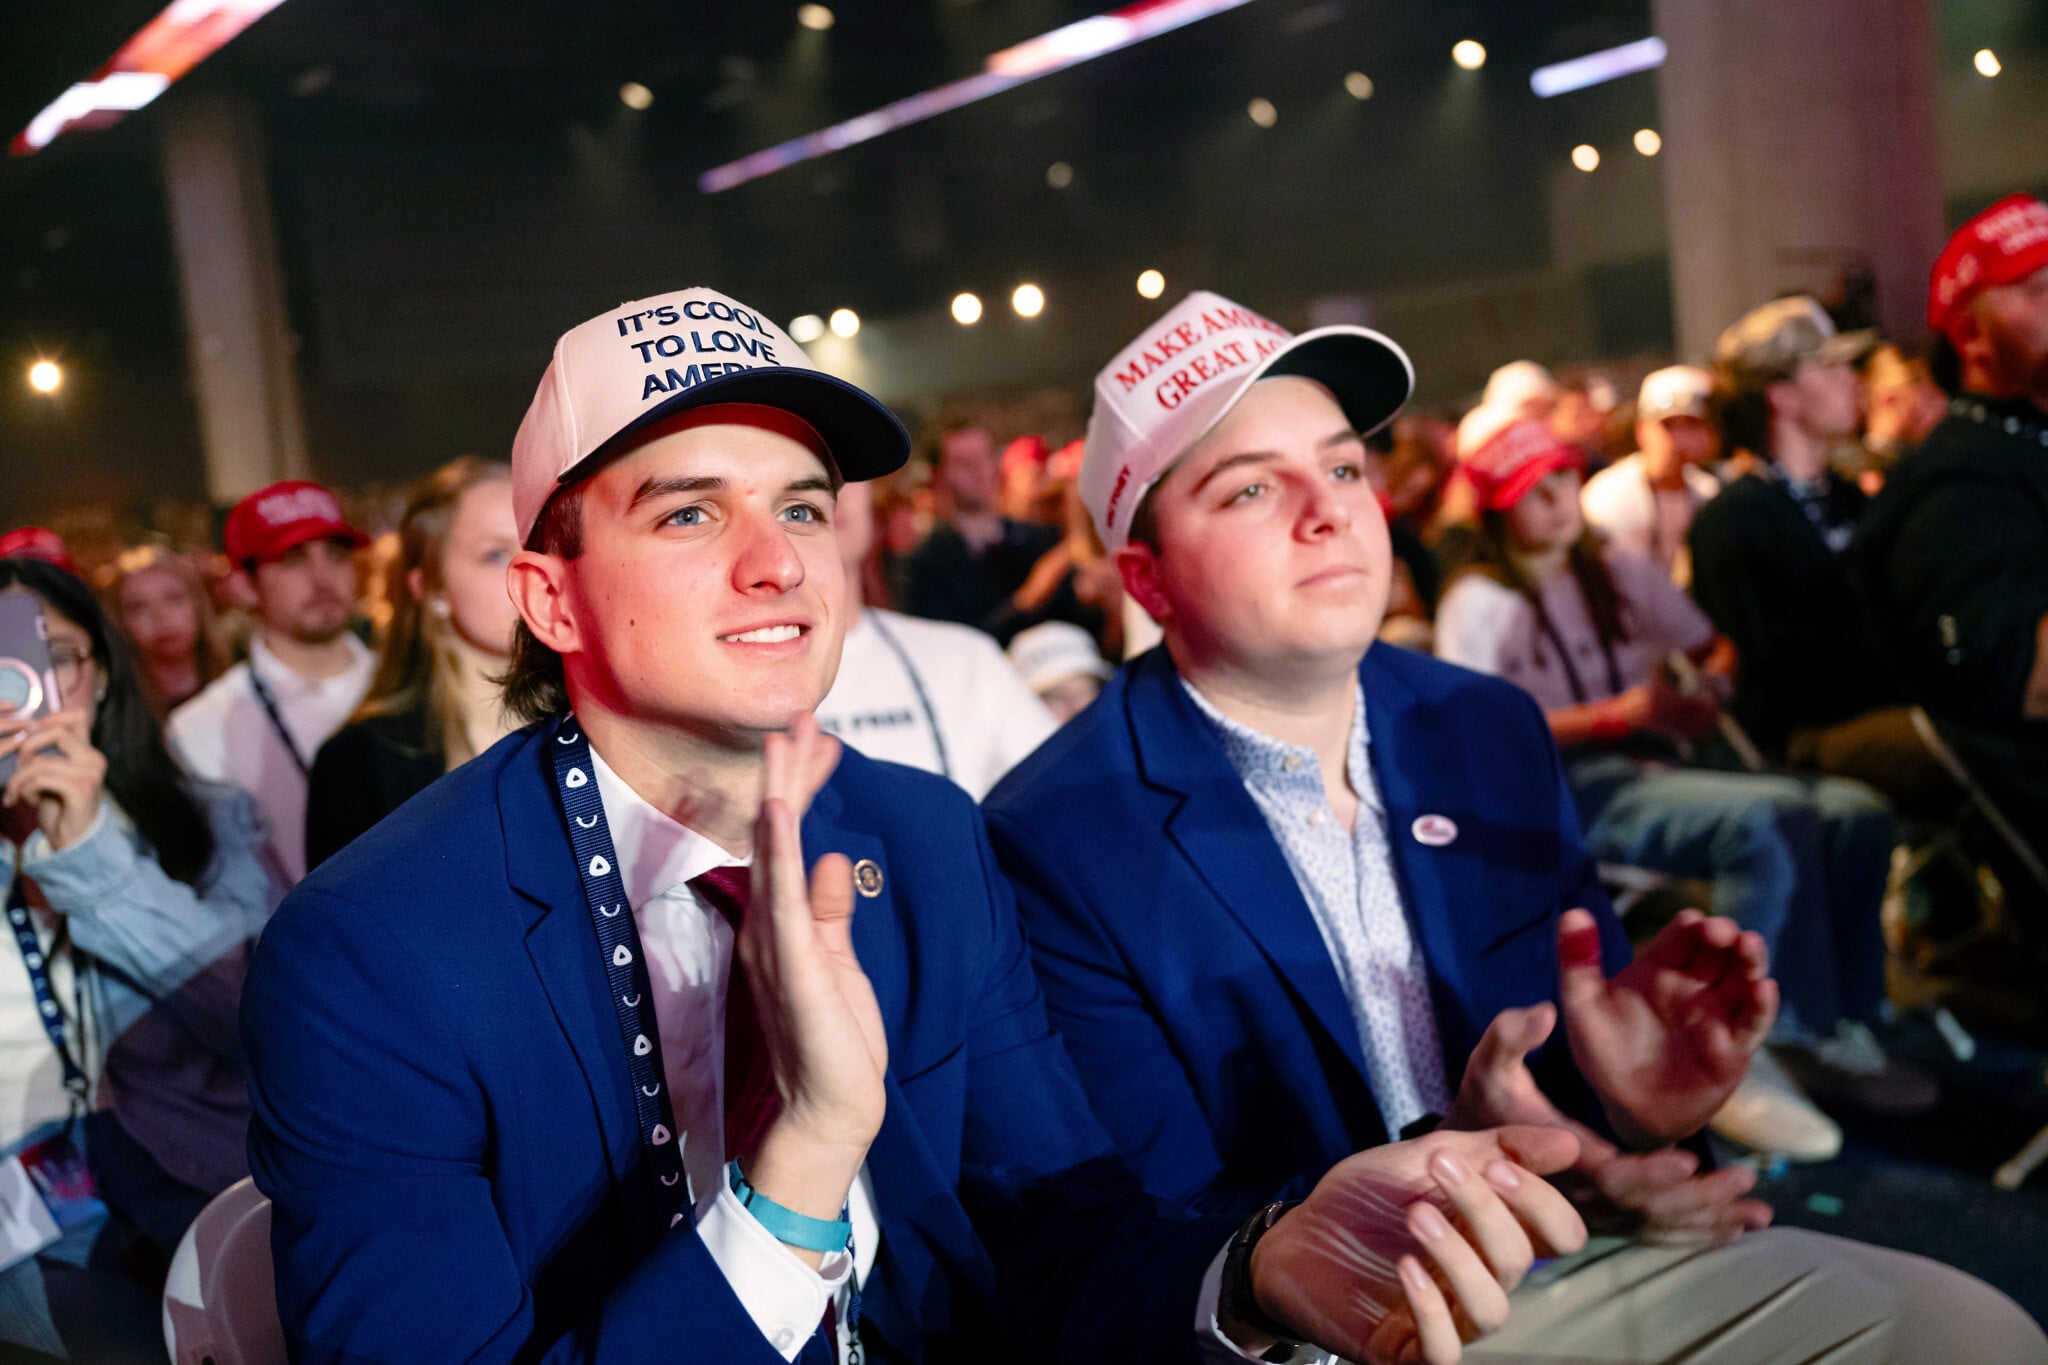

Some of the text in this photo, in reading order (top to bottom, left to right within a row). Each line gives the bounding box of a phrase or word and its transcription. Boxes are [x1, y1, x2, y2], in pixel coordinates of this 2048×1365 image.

[616, 300, 775, 340] IT'S COOL
[630, 329, 781, 367] TO LOVE
[1114, 321, 1203, 395] MAKE
[641, 361, 753, 401] AMER
[1155, 340, 1251, 411] GREAT
